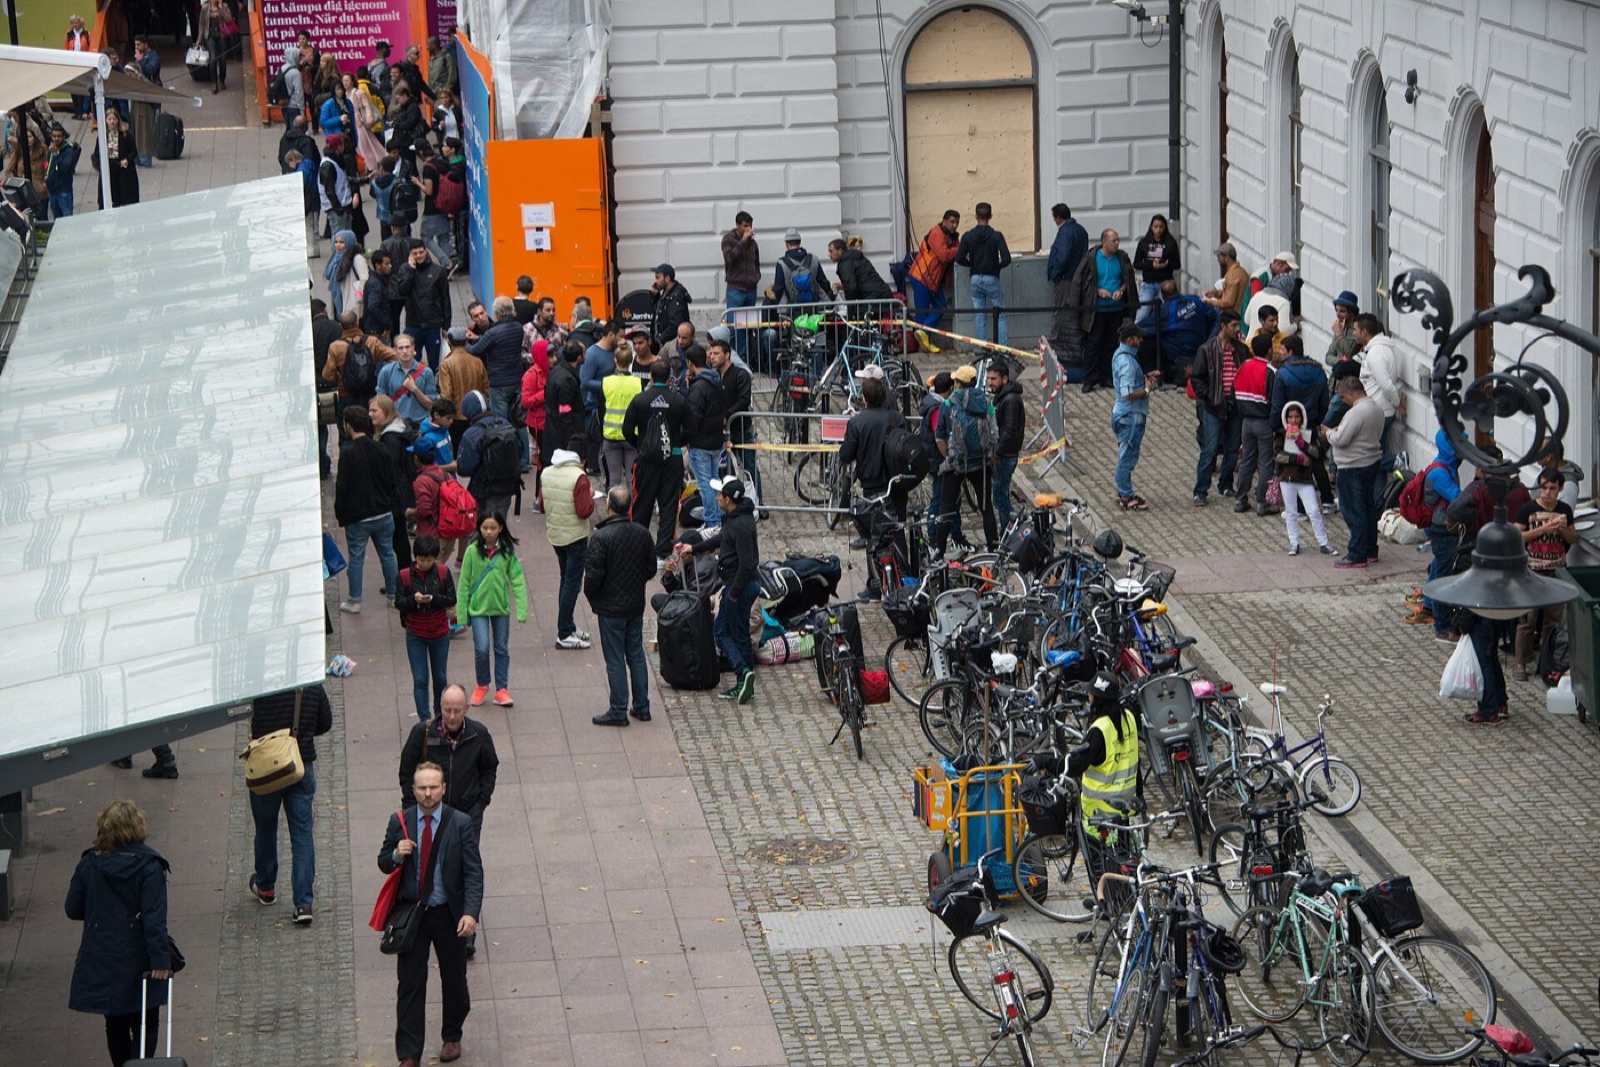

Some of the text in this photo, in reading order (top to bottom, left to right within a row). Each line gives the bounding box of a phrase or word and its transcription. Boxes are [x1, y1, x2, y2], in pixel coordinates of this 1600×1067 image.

[264, 0, 387, 14] du kämpa dig igenom
[264, 10, 400, 26] tunneln. När du kommit
[265, 23, 382, 40] ut på ndra sidan så
[266, 40, 318, 51] kommr
[319, 38, 338, 49] det
[339, 39, 366, 48] vara
[331, 49, 366, 60] ntrén.
